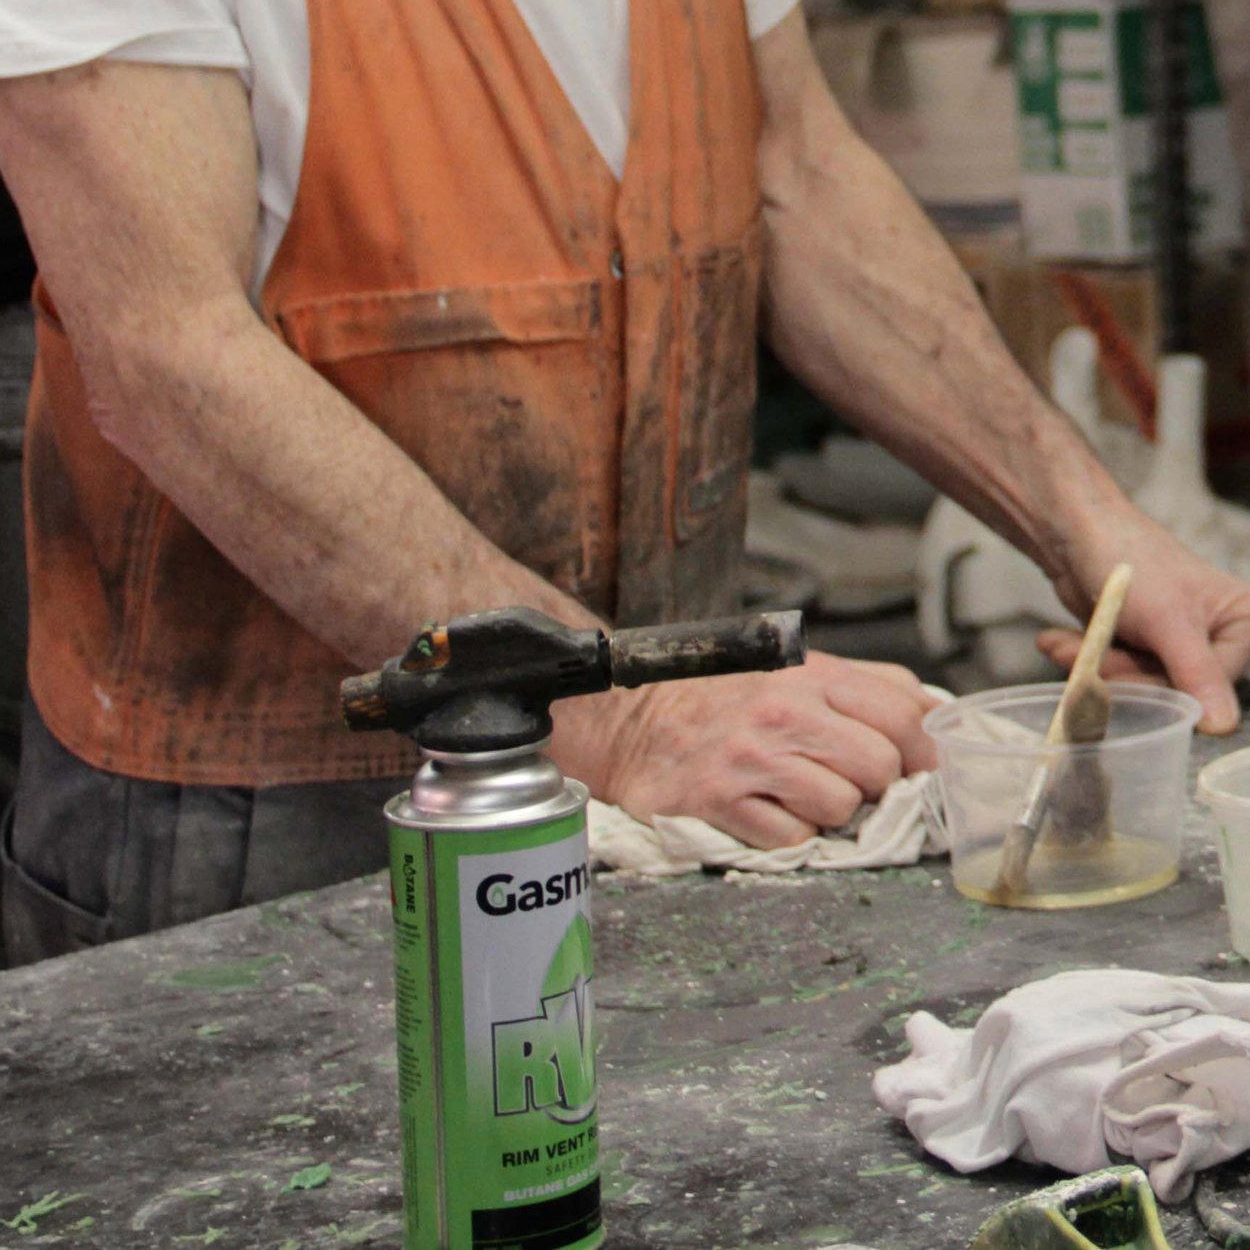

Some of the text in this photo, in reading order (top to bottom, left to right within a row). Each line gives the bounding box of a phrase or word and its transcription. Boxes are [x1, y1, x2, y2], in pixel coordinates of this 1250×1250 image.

[476, 862, 590, 916] Gasm
[502, 1148, 539, 1167] RIM
[546, 1132, 585, 1159] VENT
[546, 1153, 584, 1176] SAFETY
[504, 1179, 564, 1201] BUTANE
